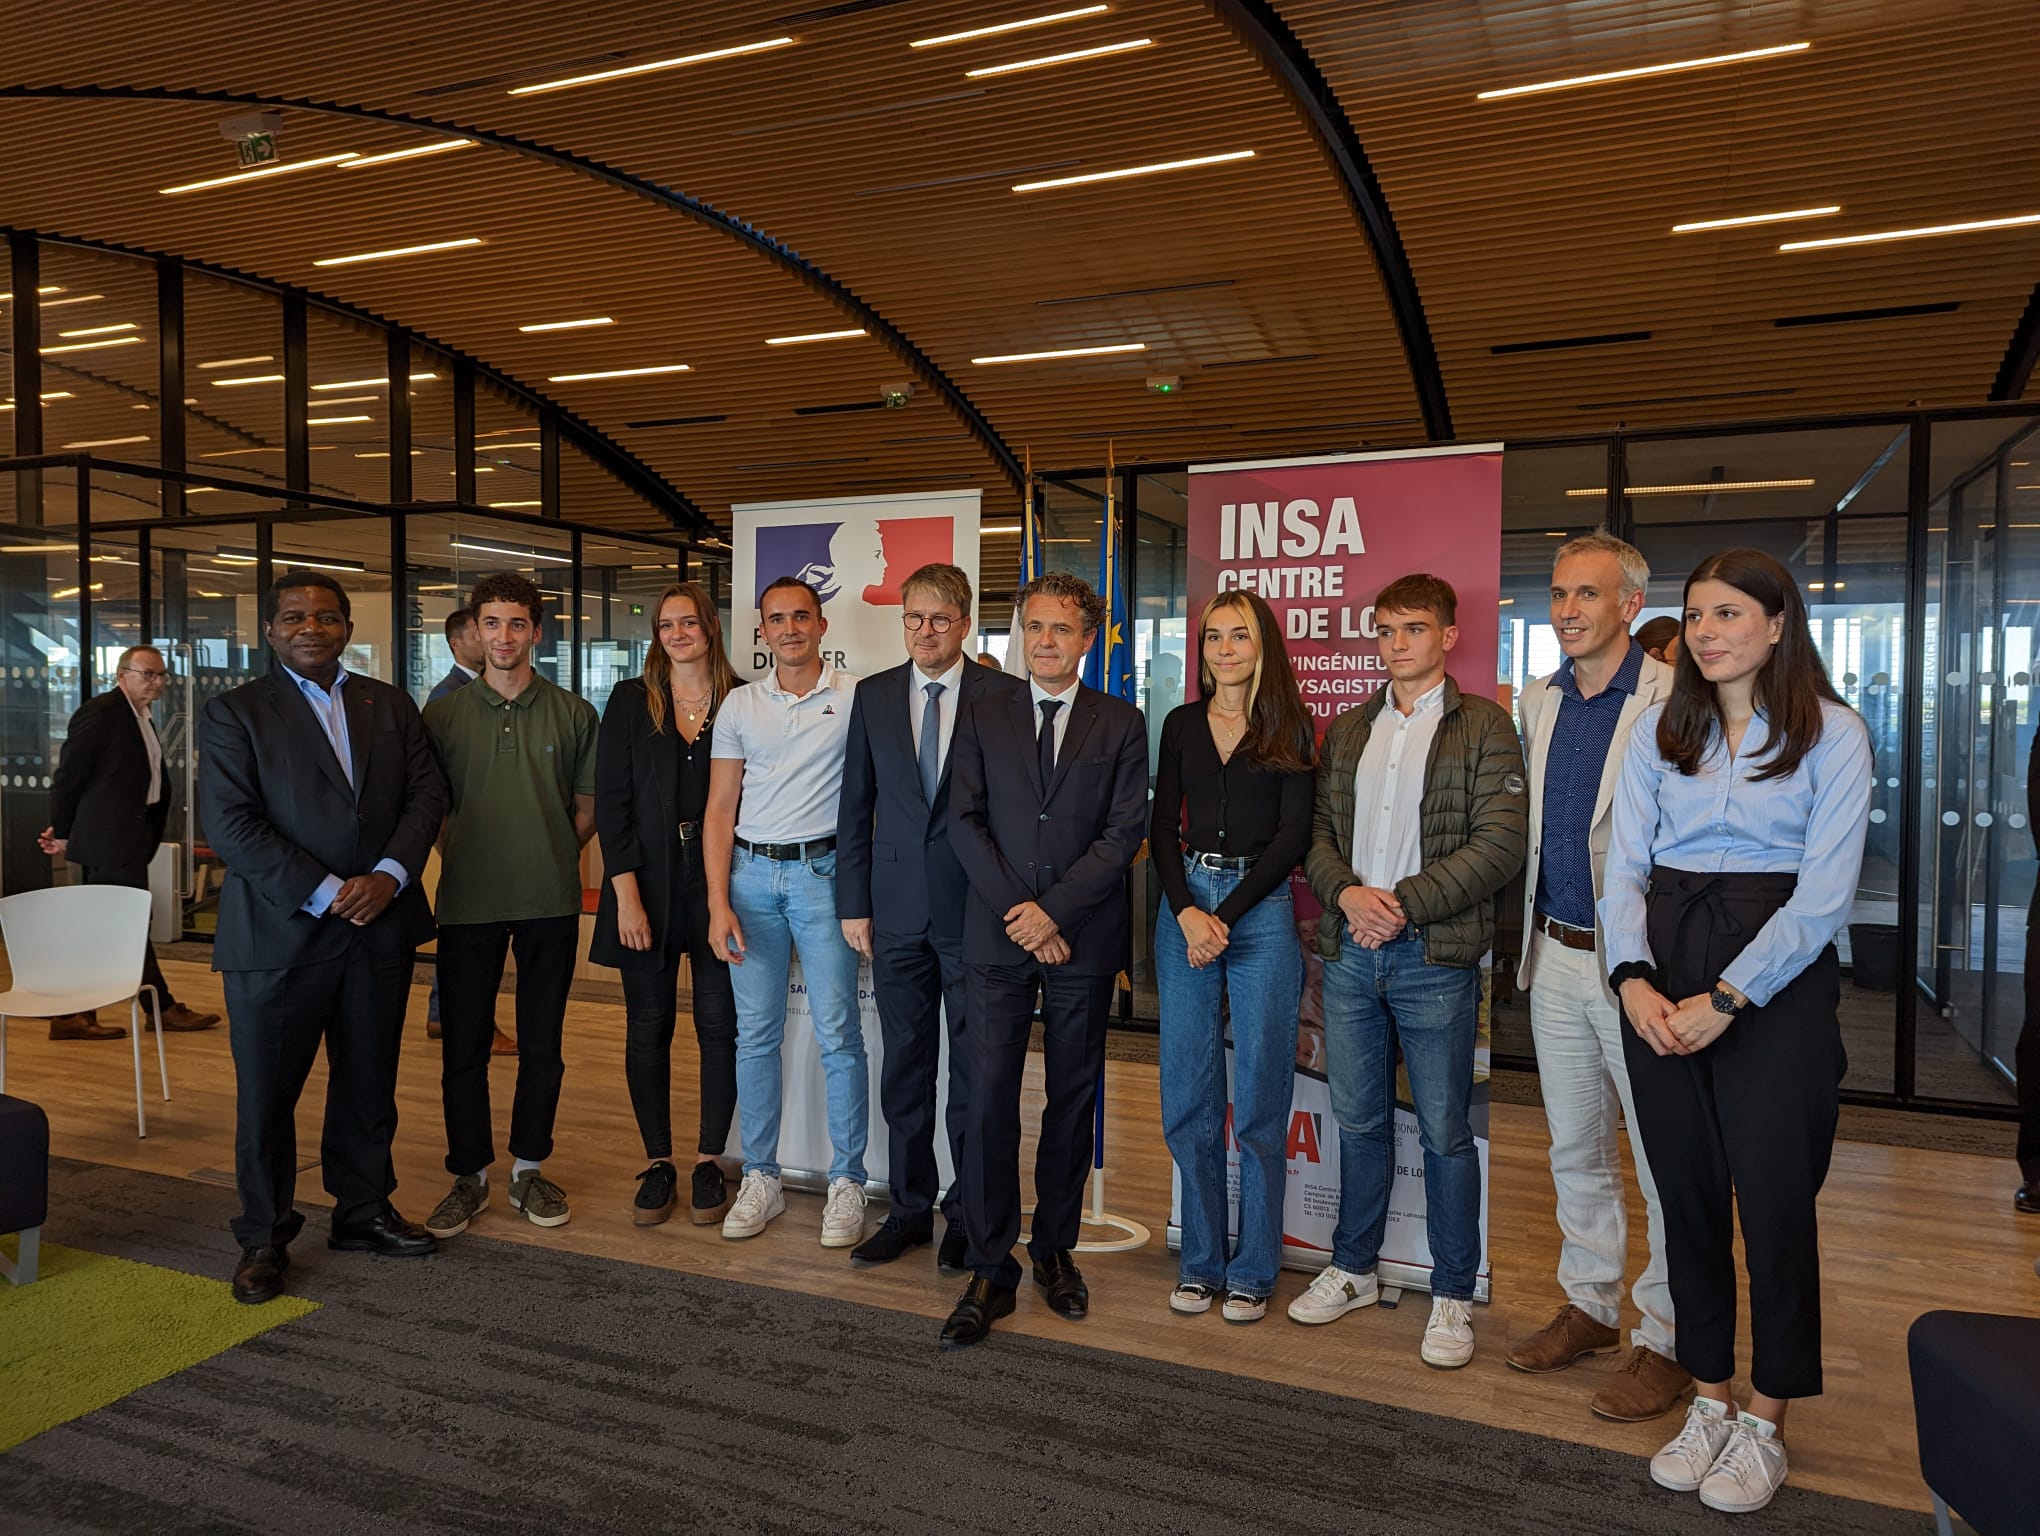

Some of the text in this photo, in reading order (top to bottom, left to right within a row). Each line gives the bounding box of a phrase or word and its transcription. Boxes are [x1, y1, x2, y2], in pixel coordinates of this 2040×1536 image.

[1220, 497, 1366, 560] INSA
[1218, 566, 1344, 599] CENTRE
[1287, 608, 1329, 639] DE
[1397, 1165, 1409, 1176] DE
